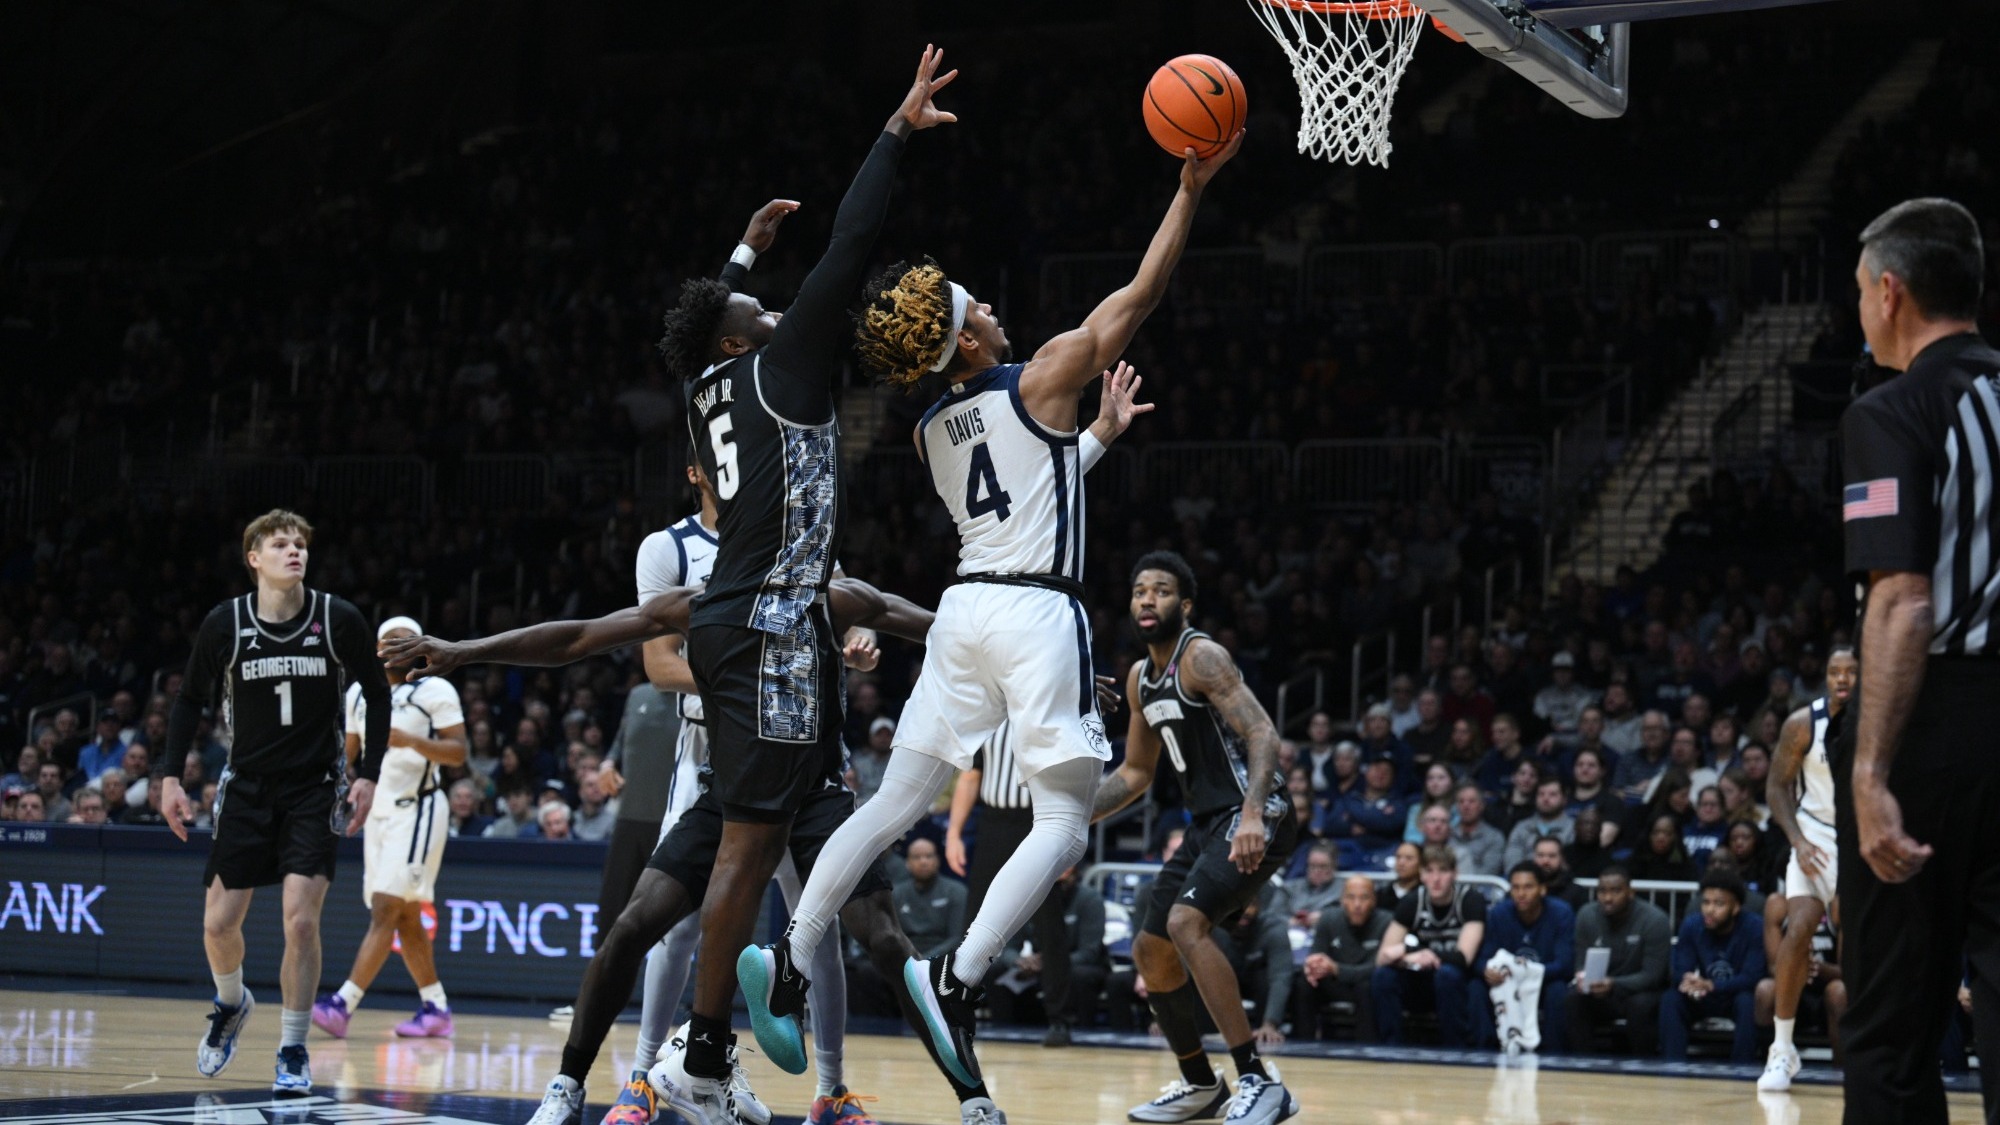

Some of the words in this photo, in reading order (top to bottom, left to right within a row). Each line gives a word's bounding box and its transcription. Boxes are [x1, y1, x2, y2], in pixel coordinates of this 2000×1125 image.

[721, 378, 735, 402] JR.
[944, 406, 985, 447] DAVIS
[708, 411, 740, 501] 5
[965, 441, 1012, 523] 4
[241, 656, 327, 681] GEORGETOWN
[274, 681, 292, 726] 1
[1160, 725, 1187, 773] 0
